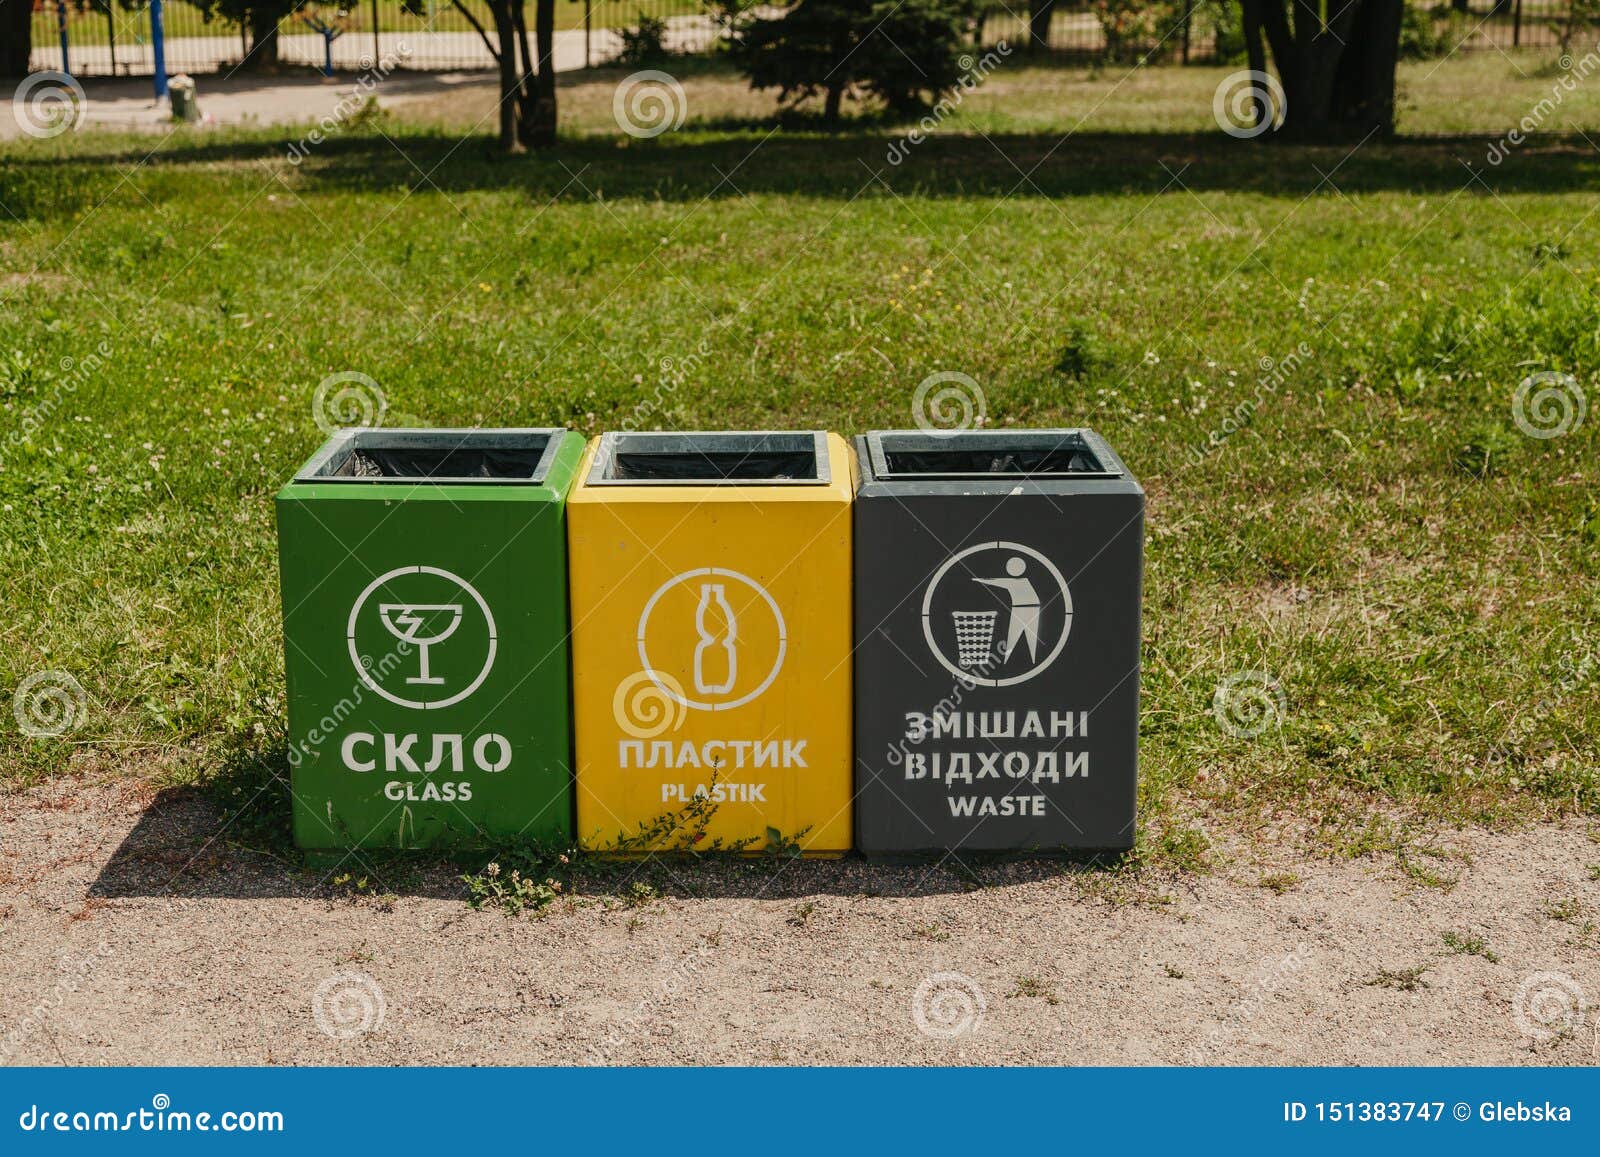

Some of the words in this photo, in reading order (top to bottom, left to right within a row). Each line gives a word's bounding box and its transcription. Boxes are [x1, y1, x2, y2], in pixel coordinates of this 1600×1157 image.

[905, 711, 1088, 739] ЗМІШАНІ
[341, 732, 512, 772] СКЛО
[618, 740, 808, 768] ПЛАСТИК
[904, 751, 1089, 785] ВІДХОДИ
[384, 781, 473, 802] GLASS
[661, 783, 767, 803] PLASTIK
[948, 796, 1046, 817] WASTE
